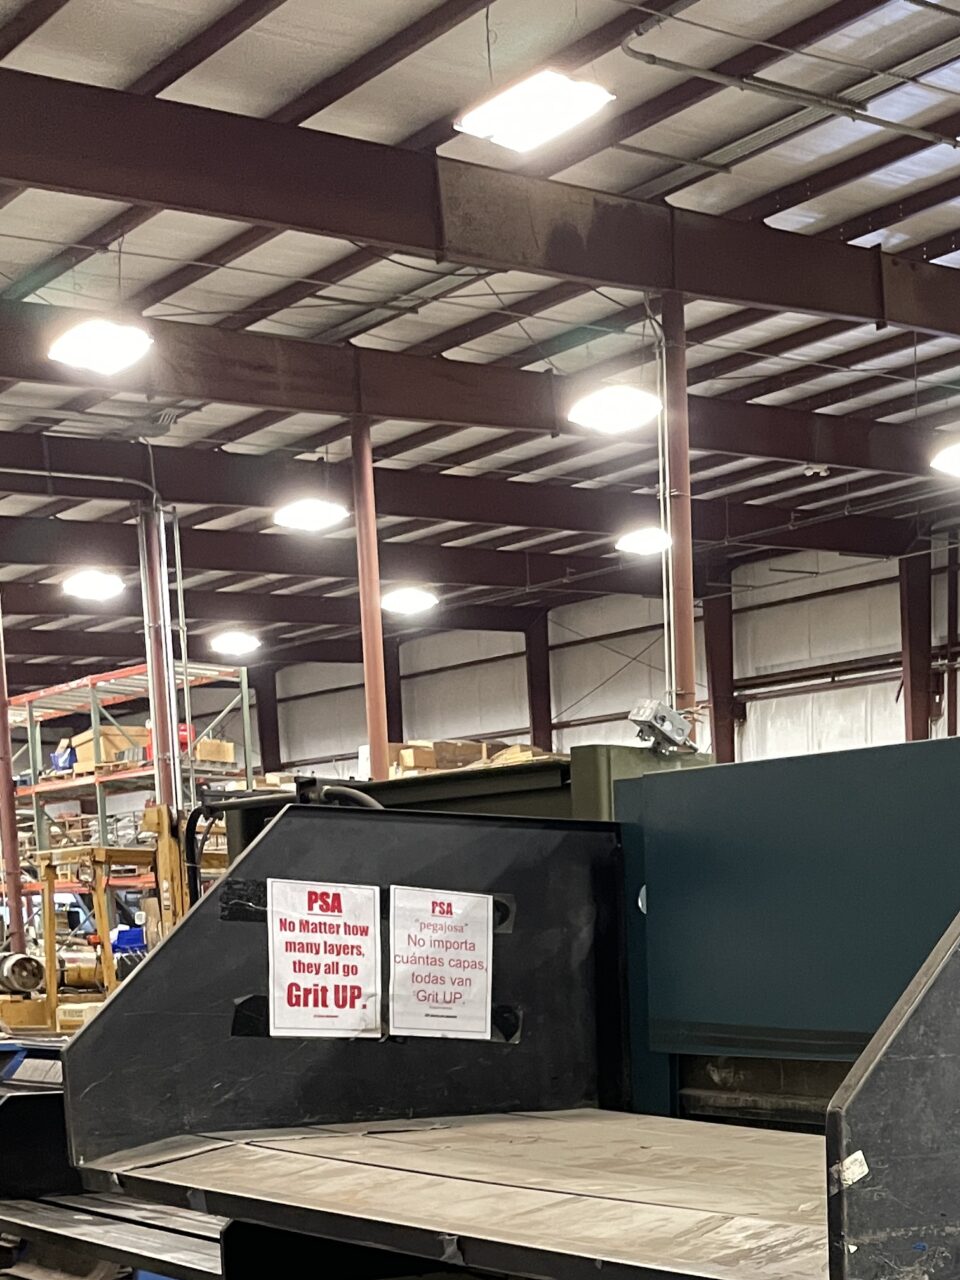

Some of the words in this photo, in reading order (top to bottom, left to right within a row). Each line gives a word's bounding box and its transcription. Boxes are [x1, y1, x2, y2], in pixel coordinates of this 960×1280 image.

[307, 891, 342, 913] PSA
[432, 901, 453, 915] PSA
[279, 918, 296, 932] No
[299, 919, 341, 935] Matter
[343, 921, 369, 937] how
[285, 941, 320, 956] many
[323, 941, 365, 958] layers,
[407, 934, 425, 948] No
[429, 936, 476, 952] importa
[292, 960, 321, 976] they
[324, 961, 340, 975] all
[342, 964, 358, 977] go
[394, 953, 444, 967] cuántas
[448, 958, 488, 973] capas,
[411, 971, 446, 985] todas
[450, 977, 472, 987] van
[287, 982, 328, 1008] Grit
[333, 984, 367, 1010] UP.
